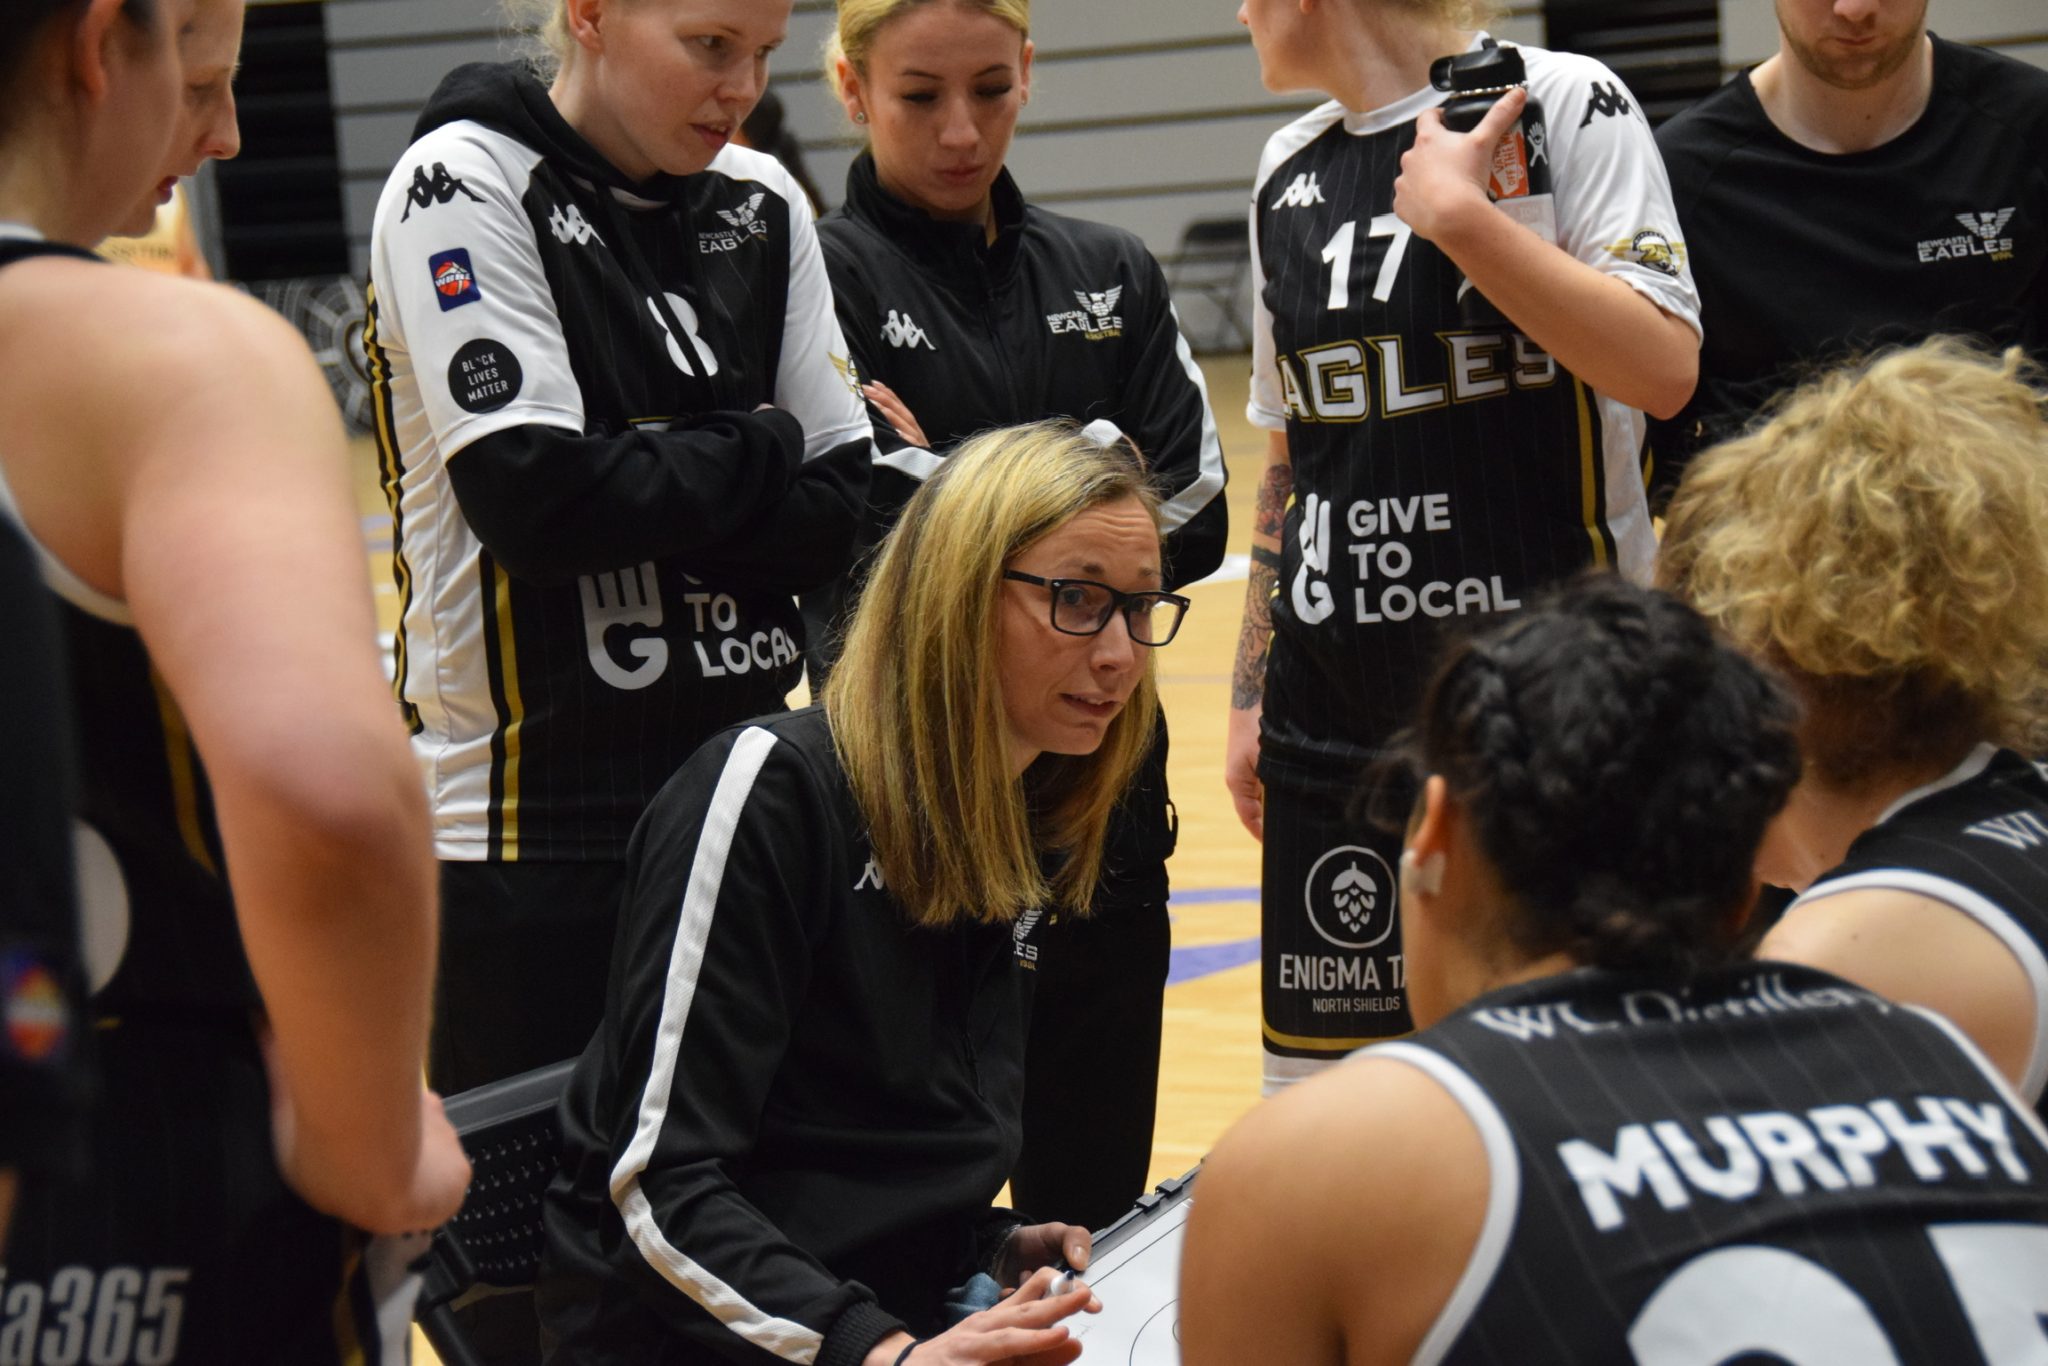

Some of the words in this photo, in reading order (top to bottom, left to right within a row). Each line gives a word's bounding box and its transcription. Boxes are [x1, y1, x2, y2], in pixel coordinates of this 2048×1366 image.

[699, 219, 767, 254] EAGLES
[1918, 238, 2013, 262] EAGLES
[435, 272, 472, 288] WBBL
[1321, 212, 1412, 310] 17
[646, 291, 719, 377] 8
[466, 380, 509, 403] MATTER
[467, 367, 499, 386] LIVES
[1276, 331, 1557, 422] AGLES
[1347, 493, 1451, 537] GIVE
[1348, 541, 1412, 580] TO
[683, 592, 738, 633] TO
[1355, 575, 1521, 624] LOCAL
[1279, 953, 1381, 991] ENIGMA
[1312, 997, 1351, 1013] NORTH
[1353, 996, 1401, 1013] SHIELDS
[1557, 1096, 2031, 1232] MURPHY
